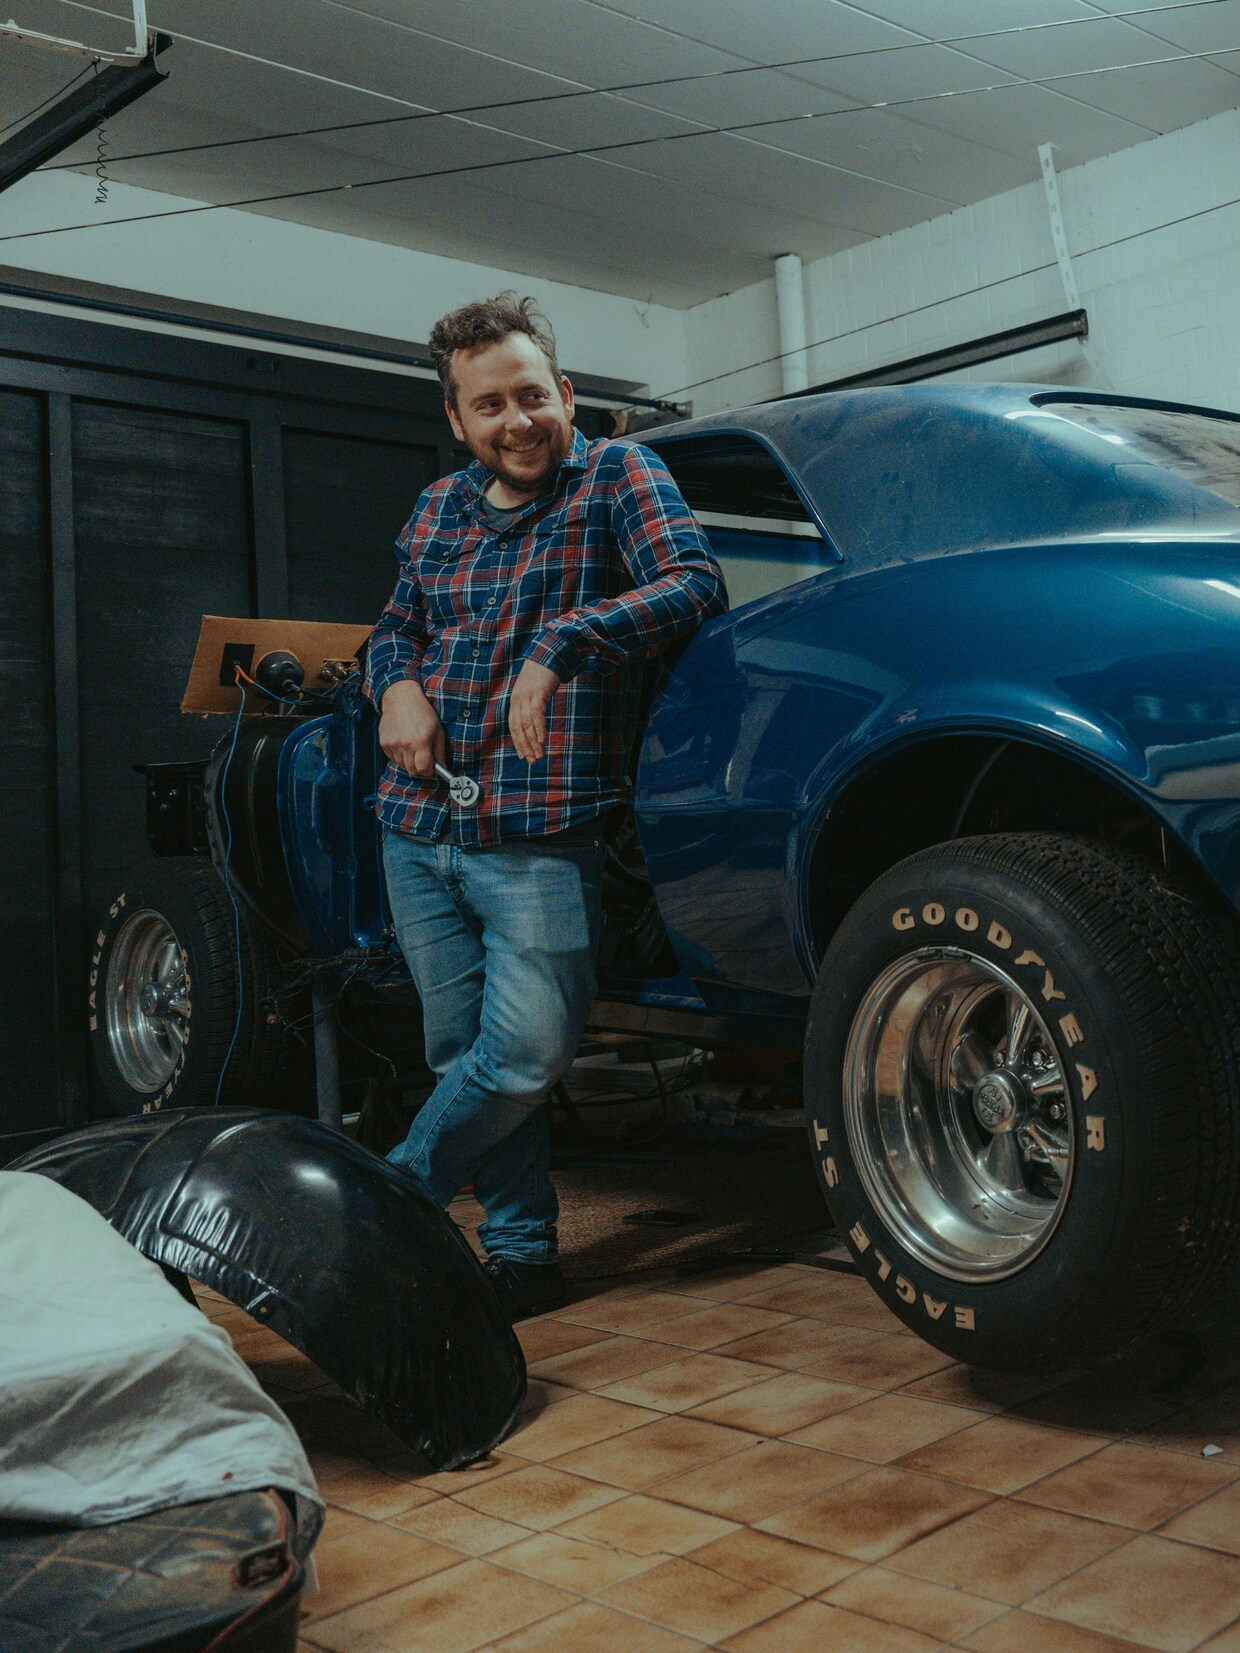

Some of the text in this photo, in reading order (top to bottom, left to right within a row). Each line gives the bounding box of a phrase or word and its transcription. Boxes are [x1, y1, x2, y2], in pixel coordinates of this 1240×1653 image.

[89, 893, 127, 1032] EAGLE ST
[891, 901, 1106, 1152] GOODYEAR
[813, 1118, 976, 1331] EAGLE ST
